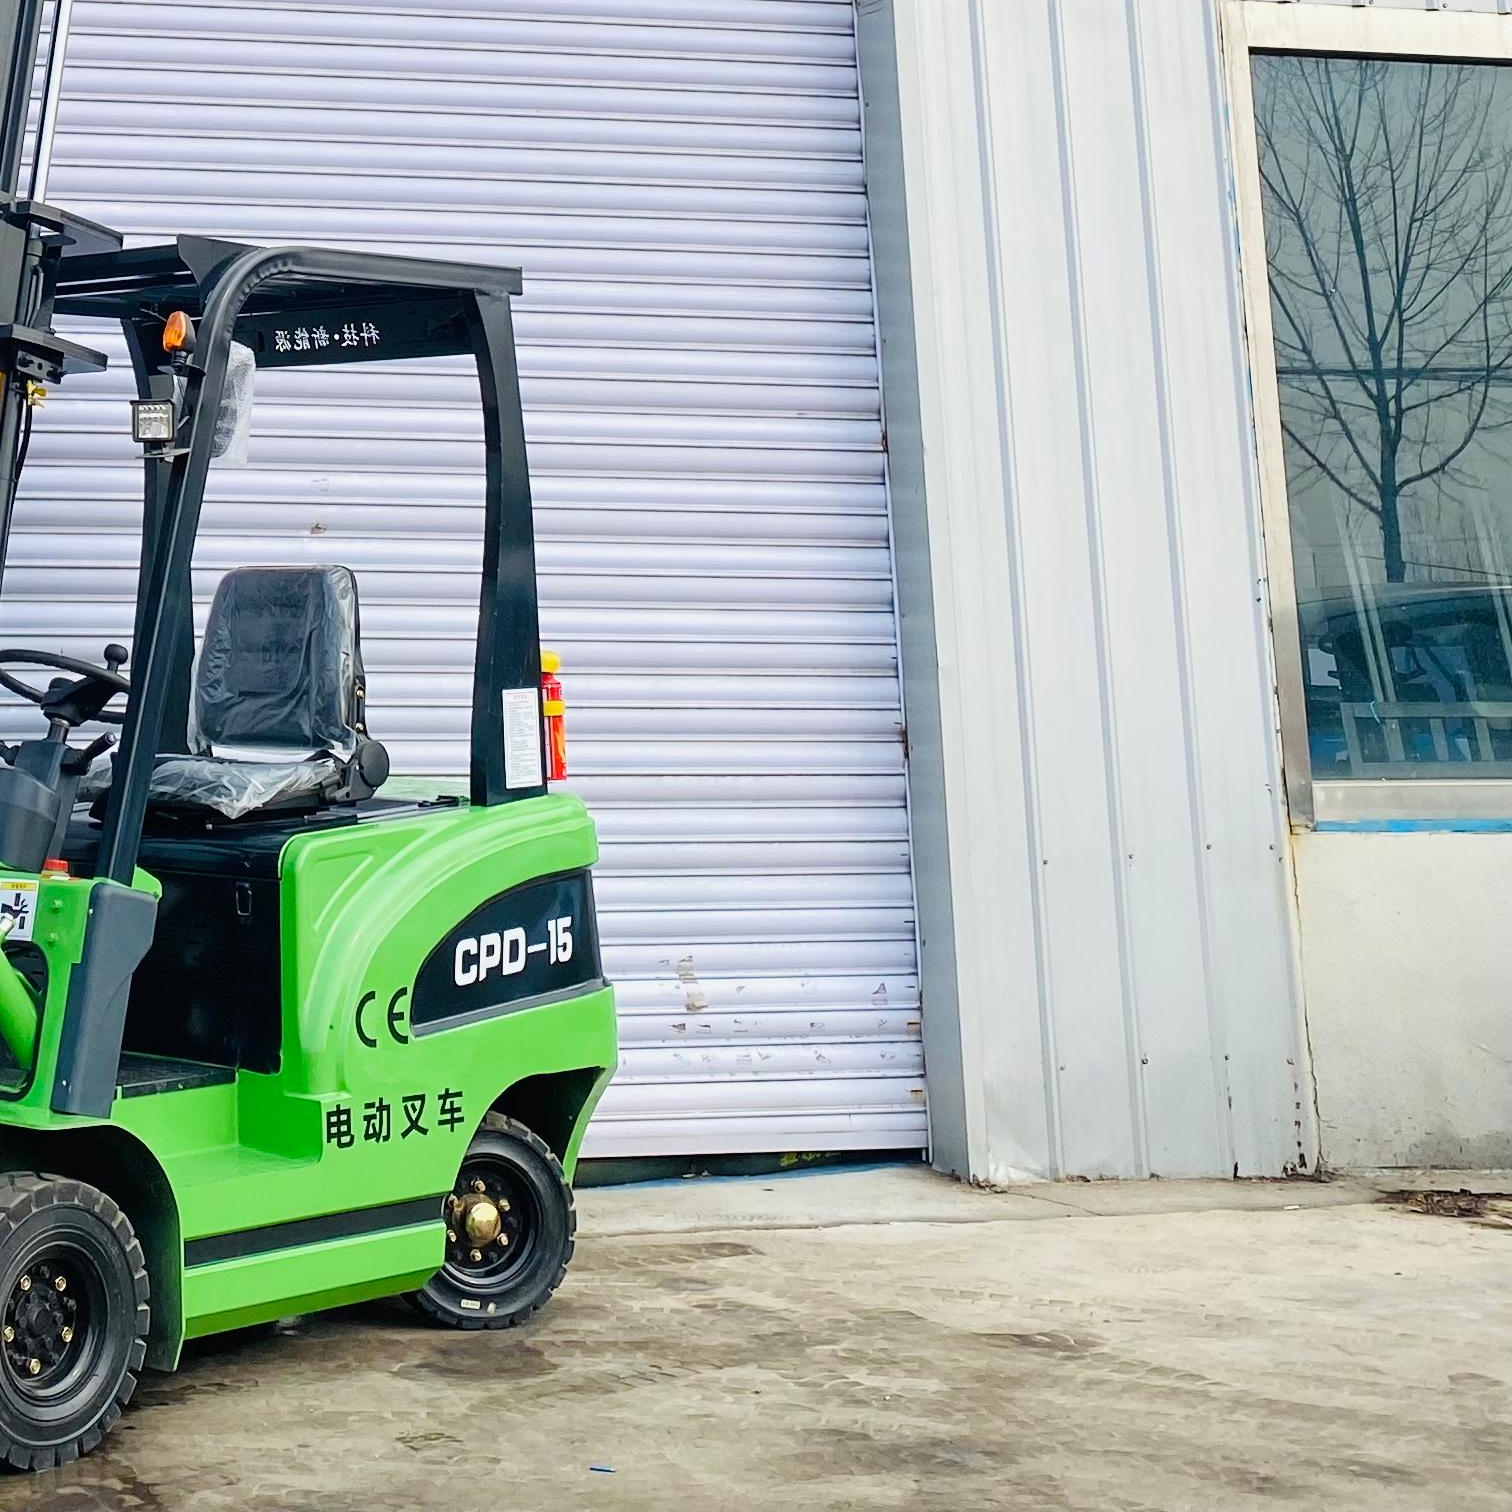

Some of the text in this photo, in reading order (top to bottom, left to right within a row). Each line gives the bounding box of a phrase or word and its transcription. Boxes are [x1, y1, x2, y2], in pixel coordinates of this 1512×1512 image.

[454, 916, 573, 986] CPD-15
[355, 986, 409, 1048] CE
[326, 1088, 465, 1149] 电动叉车
